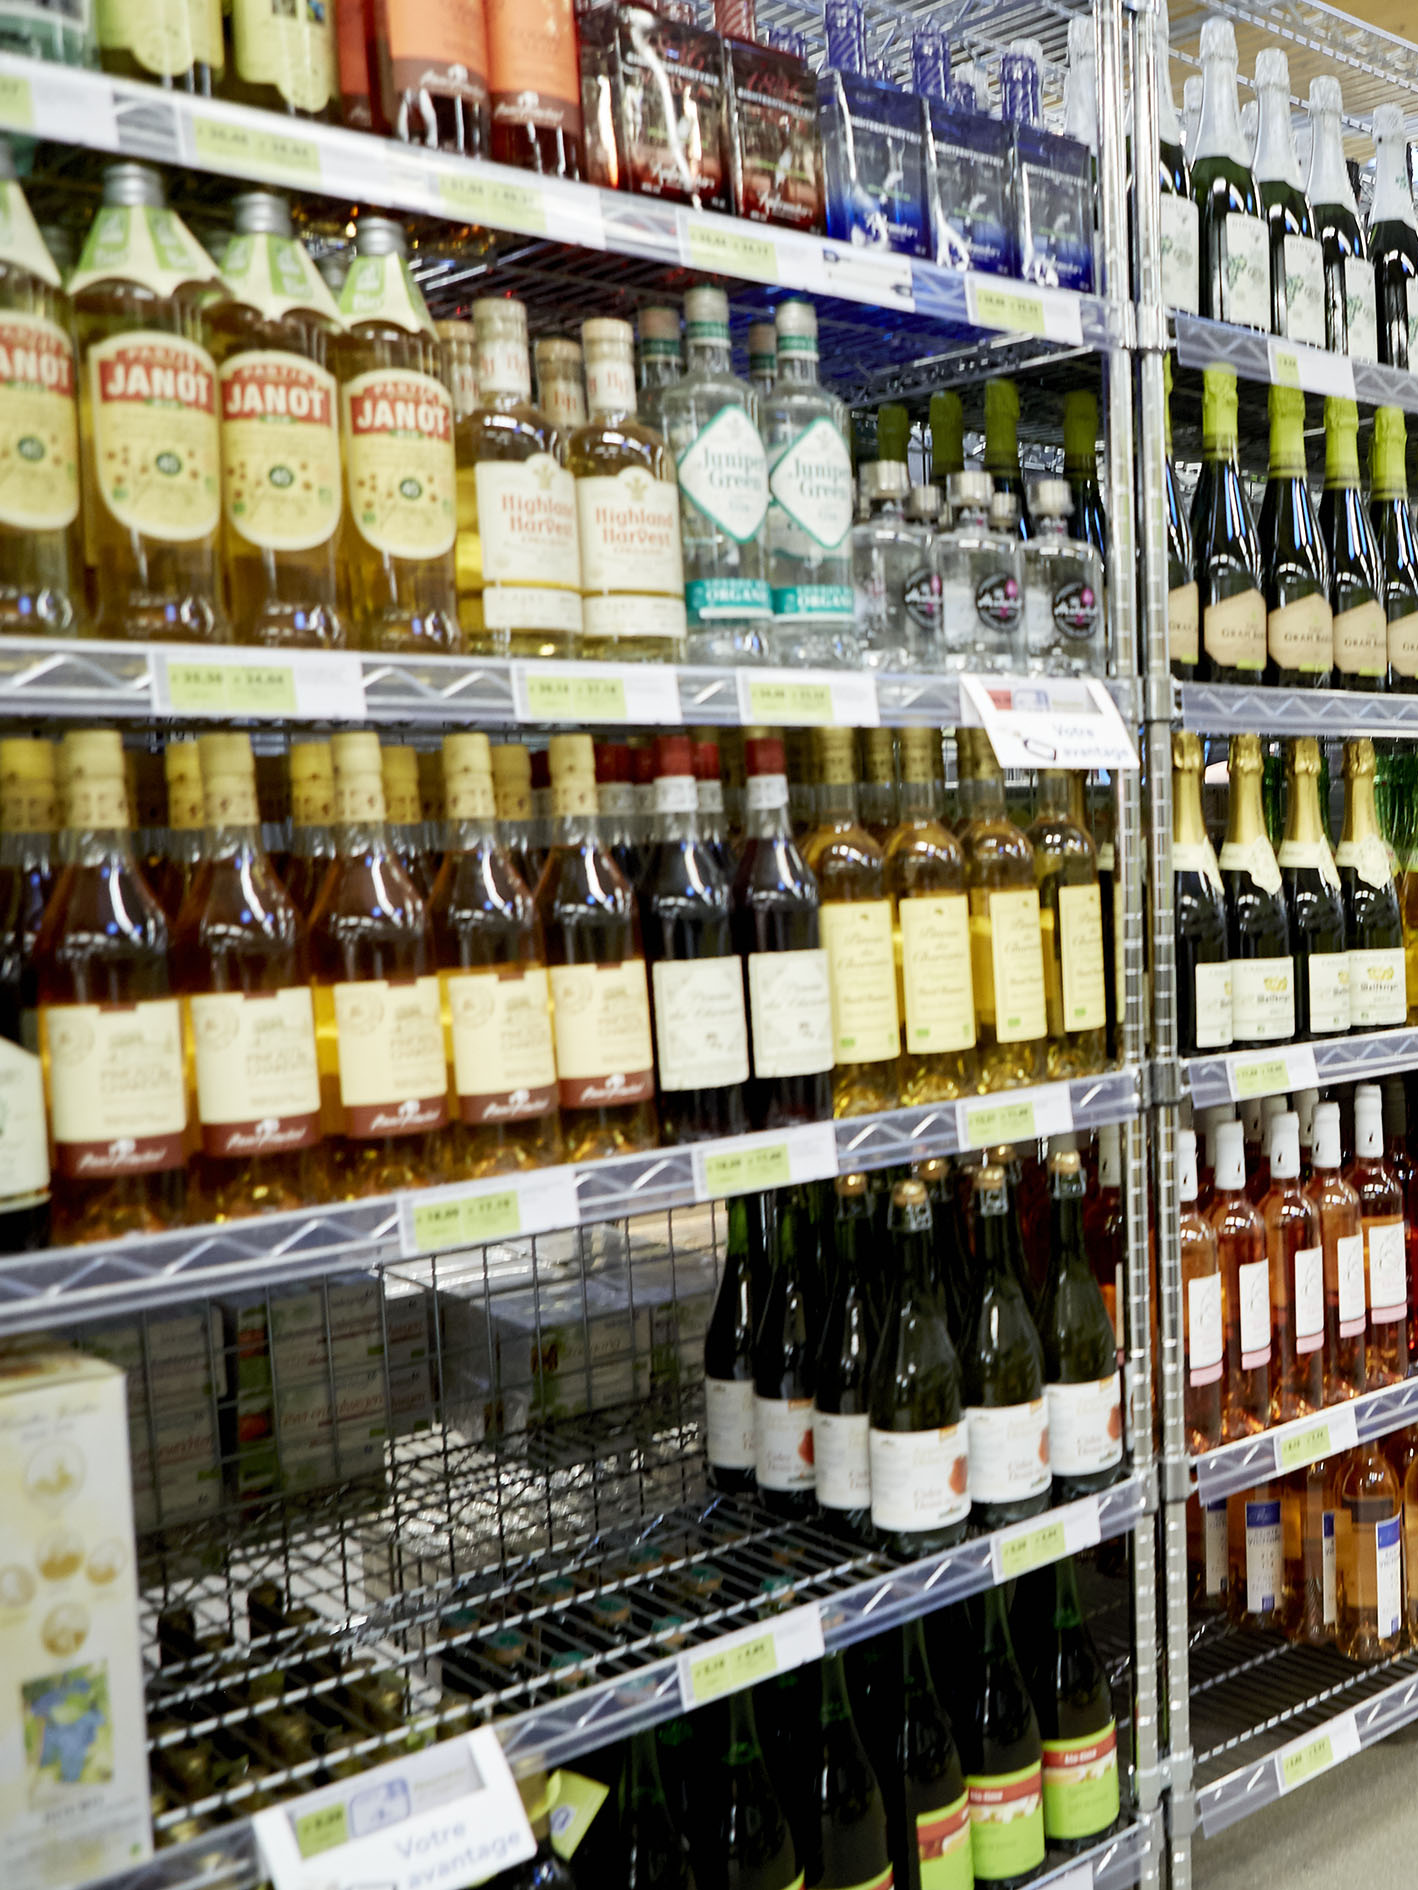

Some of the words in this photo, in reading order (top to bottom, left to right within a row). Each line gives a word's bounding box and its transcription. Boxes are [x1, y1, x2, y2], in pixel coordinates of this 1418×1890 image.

[0, 343, 69, 388] ANOT
[107, 364, 209, 404] JANOT
[226, 384, 323, 419] JANOT
[357, 400, 446, 435] JANOT
[704, 447, 766, 472] Junipe
[796, 459, 850, 481] Junipe
[596, 507, 674, 528] Highland
[602, 528, 671, 546] Harvest
[394, 1820, 466, 1859] Votre
